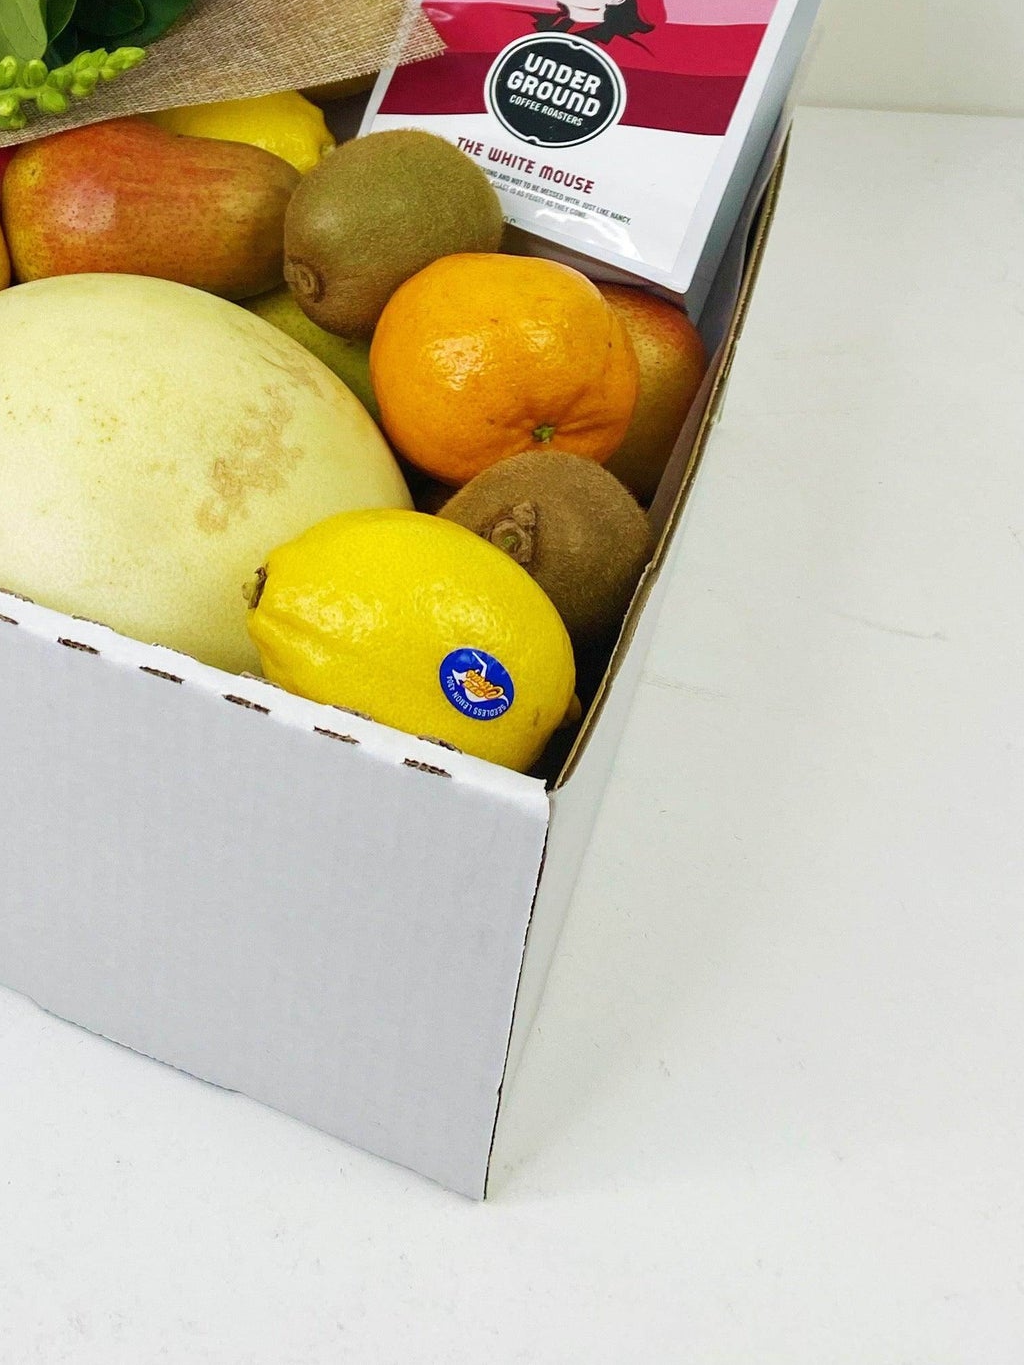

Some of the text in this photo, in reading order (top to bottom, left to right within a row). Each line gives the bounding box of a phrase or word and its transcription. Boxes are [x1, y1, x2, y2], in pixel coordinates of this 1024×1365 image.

[506, 70, 601, 117] GROUND
[524, 52, 601, 95] UNDER
[509, 94, 584, 127] COFFEE ROASTERS
[457, 137, 595, 194] THE WHITE MOUSE
[498, 173, 510, 182] AND
[511, 177, 523, 186] NOT
[523, 181, 532, 189] TO
[531, 184, 540, 192] BE
[540, 187, 564, 200] MESSED
[582, 202, 596, 211] JUST
[597, 207, 610, 216] LIKE
[452, 691, 472, 711] LEMON
[473, 704, 507, 717] SEEDLESS
